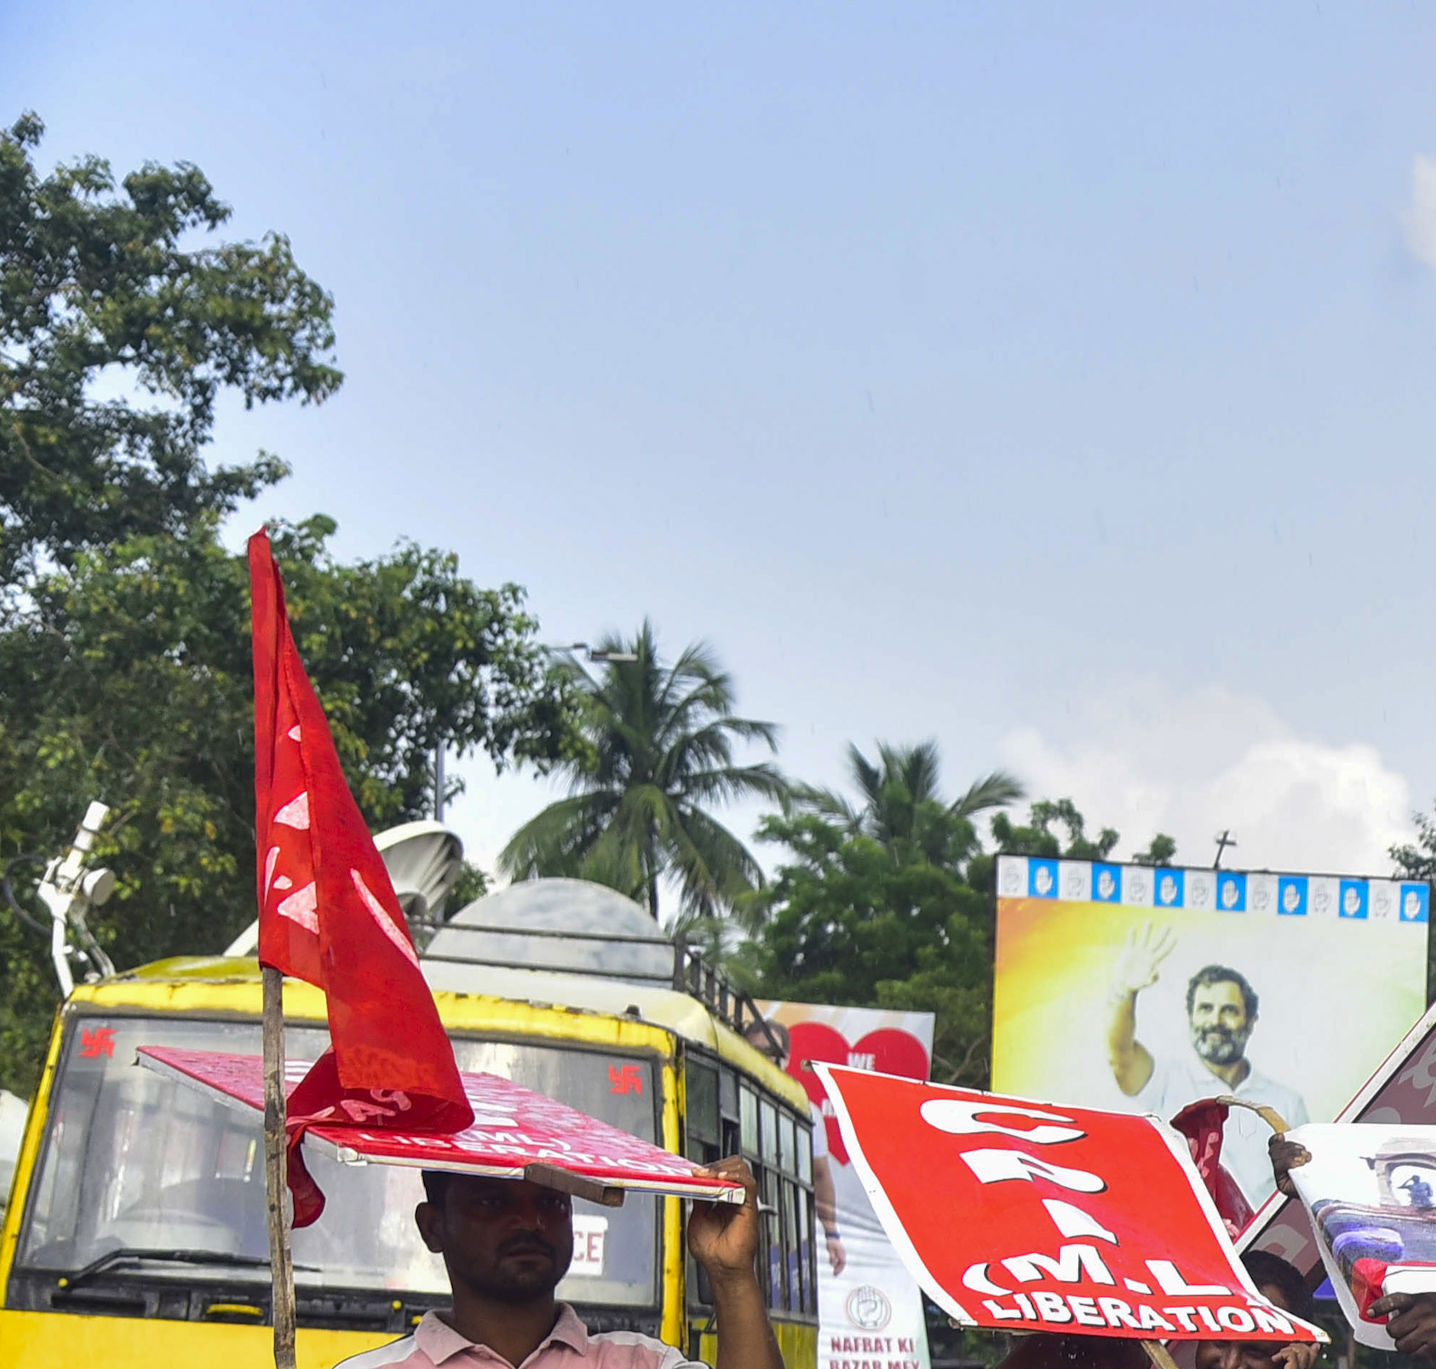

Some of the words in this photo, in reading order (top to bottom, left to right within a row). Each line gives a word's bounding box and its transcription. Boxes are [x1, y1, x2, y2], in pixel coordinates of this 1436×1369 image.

[359, 1134, 694, 1177] LIBERATION
[962, 1244, 1233, 1301] (M.L
[982, 1290, 1296, 1335] LIBERATION
[831, 1337, 892, 1353] NAFRAT
[898, 1338, 914, 1353] KI
